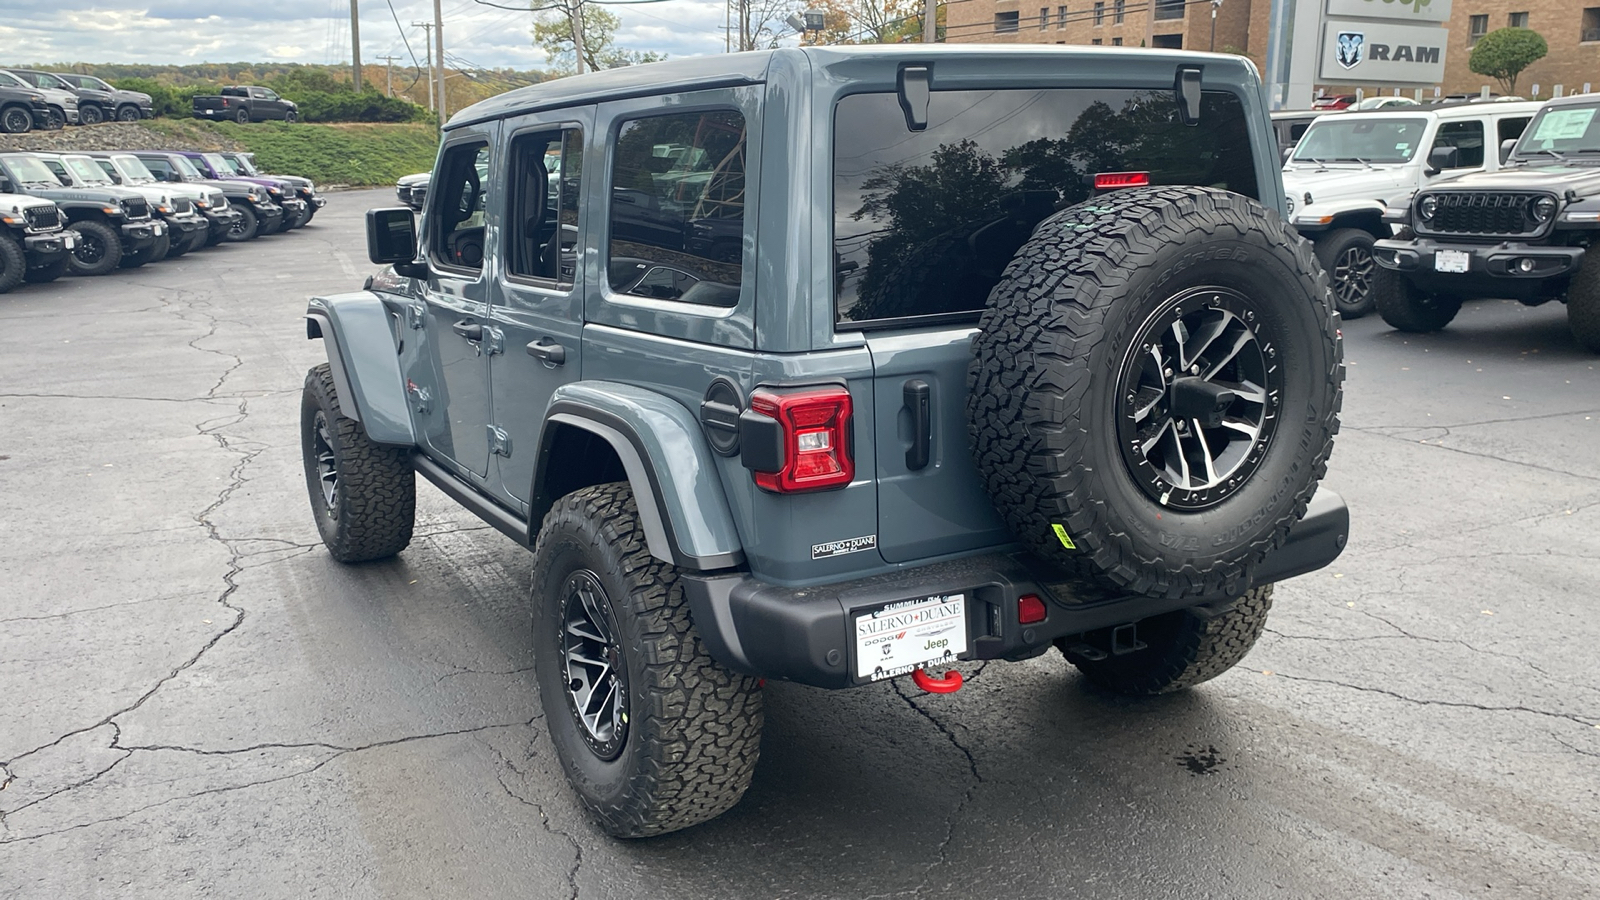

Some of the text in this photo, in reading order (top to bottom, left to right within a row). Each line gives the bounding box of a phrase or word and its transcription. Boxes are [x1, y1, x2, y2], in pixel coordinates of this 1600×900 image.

[1368, 43, 1440, 64] RAM
[814, 541, 845, 554] SALERNO
[851, 537, 874, 547] DUANE
[858, 602, 961, 636] SALERNO DUANE
[923, 638, 949, 651] Jeep
[870, 653, 958, 682] SALERNO DUANE
